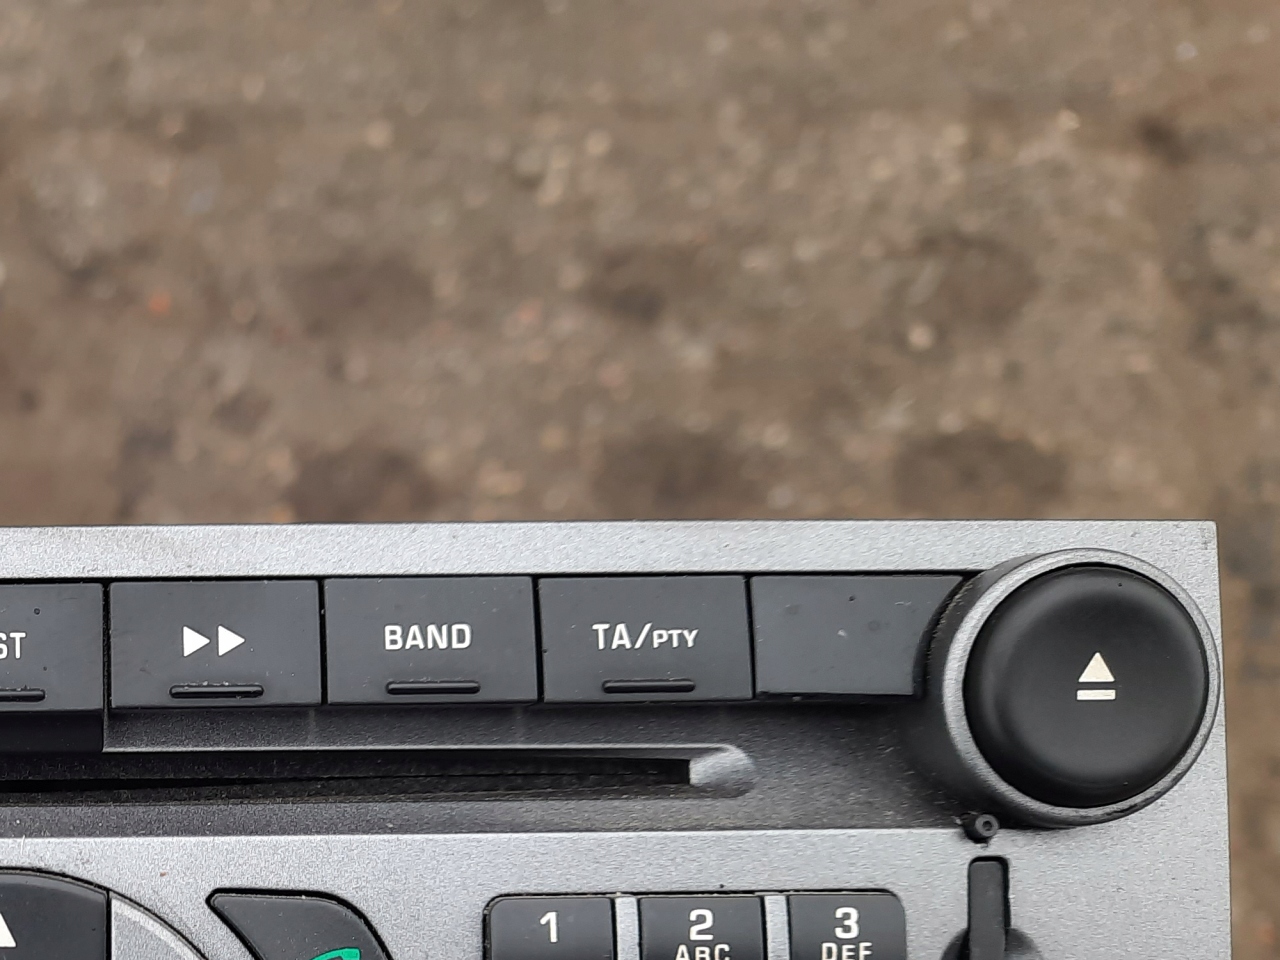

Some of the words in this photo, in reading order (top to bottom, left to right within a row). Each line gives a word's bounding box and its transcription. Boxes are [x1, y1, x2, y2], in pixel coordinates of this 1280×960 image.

[384, 623, 471, 650] BAND
[591, 622, 699, 650] TA/PTY
[539, 911, 558, 943] 1
[689, 908, 714, 941] 2
[834, 906, 859, 939] 3
